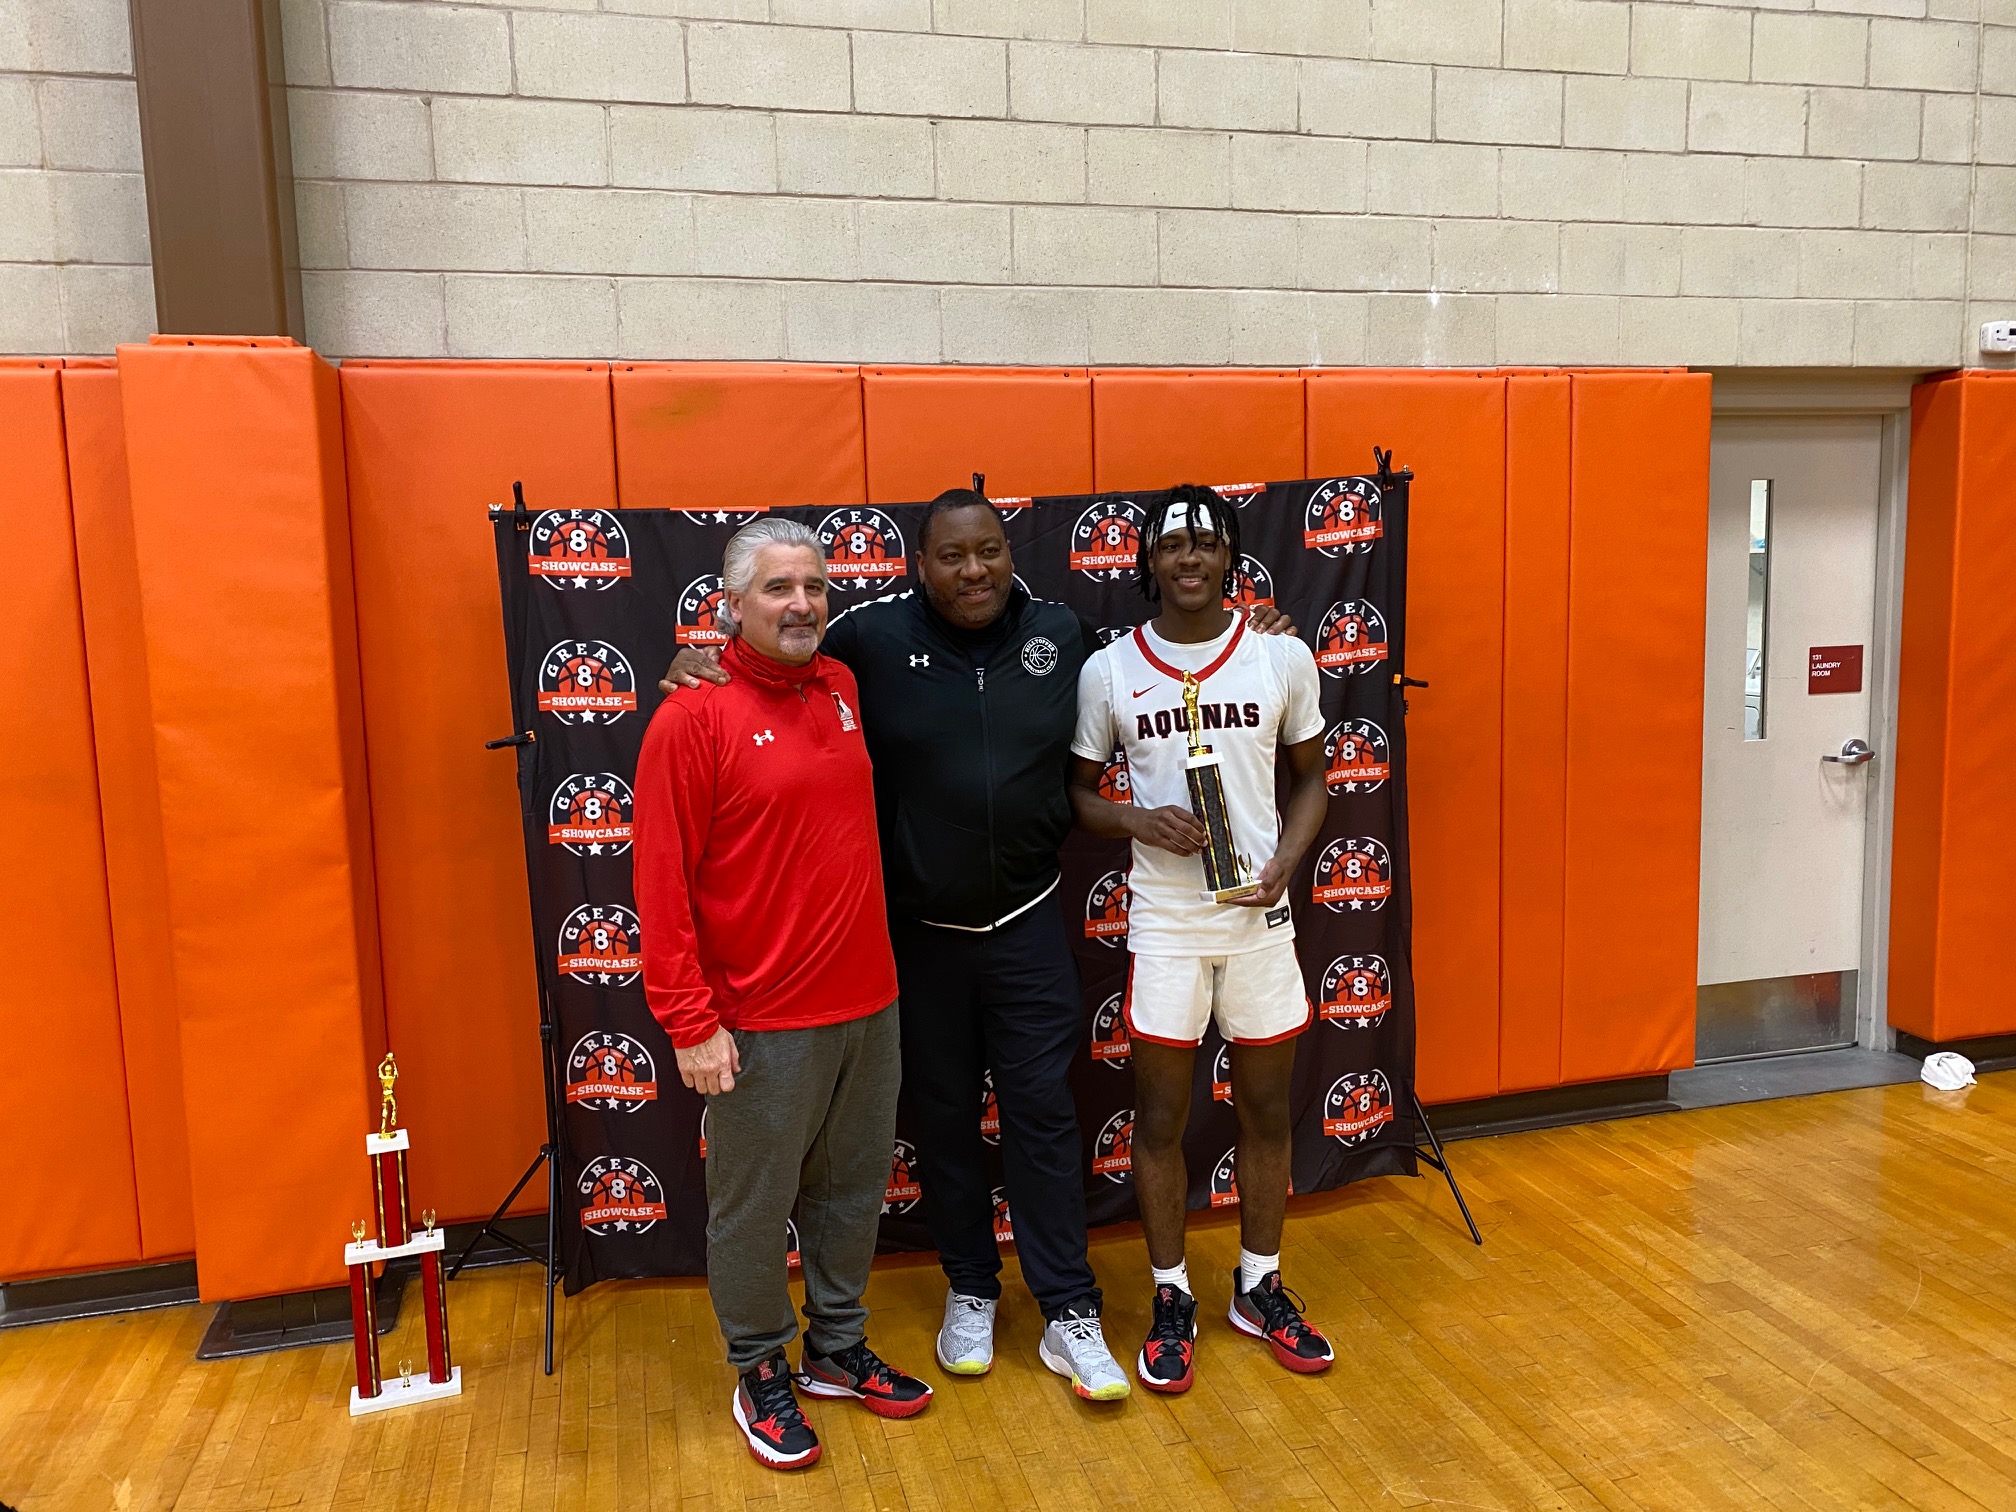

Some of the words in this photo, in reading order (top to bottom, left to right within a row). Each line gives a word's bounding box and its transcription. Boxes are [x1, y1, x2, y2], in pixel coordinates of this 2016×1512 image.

[1312, 480, 1380, 516] GREAT
[1079, 504, 1141, 538] GREA
[1340, 500, 1355, 521] 8
[536, 509, 620, 541] GREAT
[820, 511, 896, 544] GREAT
[1106, 524, 1121, 546] 8
[570, 529, 588, 552] 8
[850, 532, 867, 554] 8
[542, 561, 617, 572] SHOWCASE
[1082, 554, 1136, 565] SHOWCAS
[1322, 602, 1380, 638] GREAT
[1345, 622, 1358, 642] 8
[546, 643, 626, 676] GREAT
[577, 664, 593, 687] 8
[552, 696, 622, 706] SHOWCASE
[1136, 702, 1260, 740] AQUNAS
[1342, 740, 1356, 760] 8
[1114, 770, 1130, 791] 8
[557, 776, 632, 810] GREAT
[584, 798, 602, 819] 8
[561, 827, 631, 840] SHOWCASE
[1320, 840, 1388, 873] GREAT
[1346, 858, 1362, 878] 8
[1324, 885, 1386, 898] SHOWCASE
[566, 908, 640, 939] GREAT
[594, 928, 610, 950] 8
[570, 958, 638, 970] SHOWCASE
[1353, 976, 1369, 996] 8
[1328, 1000, 1384, 1014] SHOWCASE
[573, 1035, 646, 1068] GREAT
[603, 1055, 618, 1076] 8
[577, 1084, 644, 1097] SHOWCASE
[1330, 1074, 1386, 1106] GREAT
[1360, 1093, 1370, 1112] 8
[1336, 1111, 1384, 1132] SHOWCASE
[581, 1159, 656, 1194] GREAT
[611, 1178, 626, 1198] 8
[584, 1208, 654, 1221] SHOWCASE
